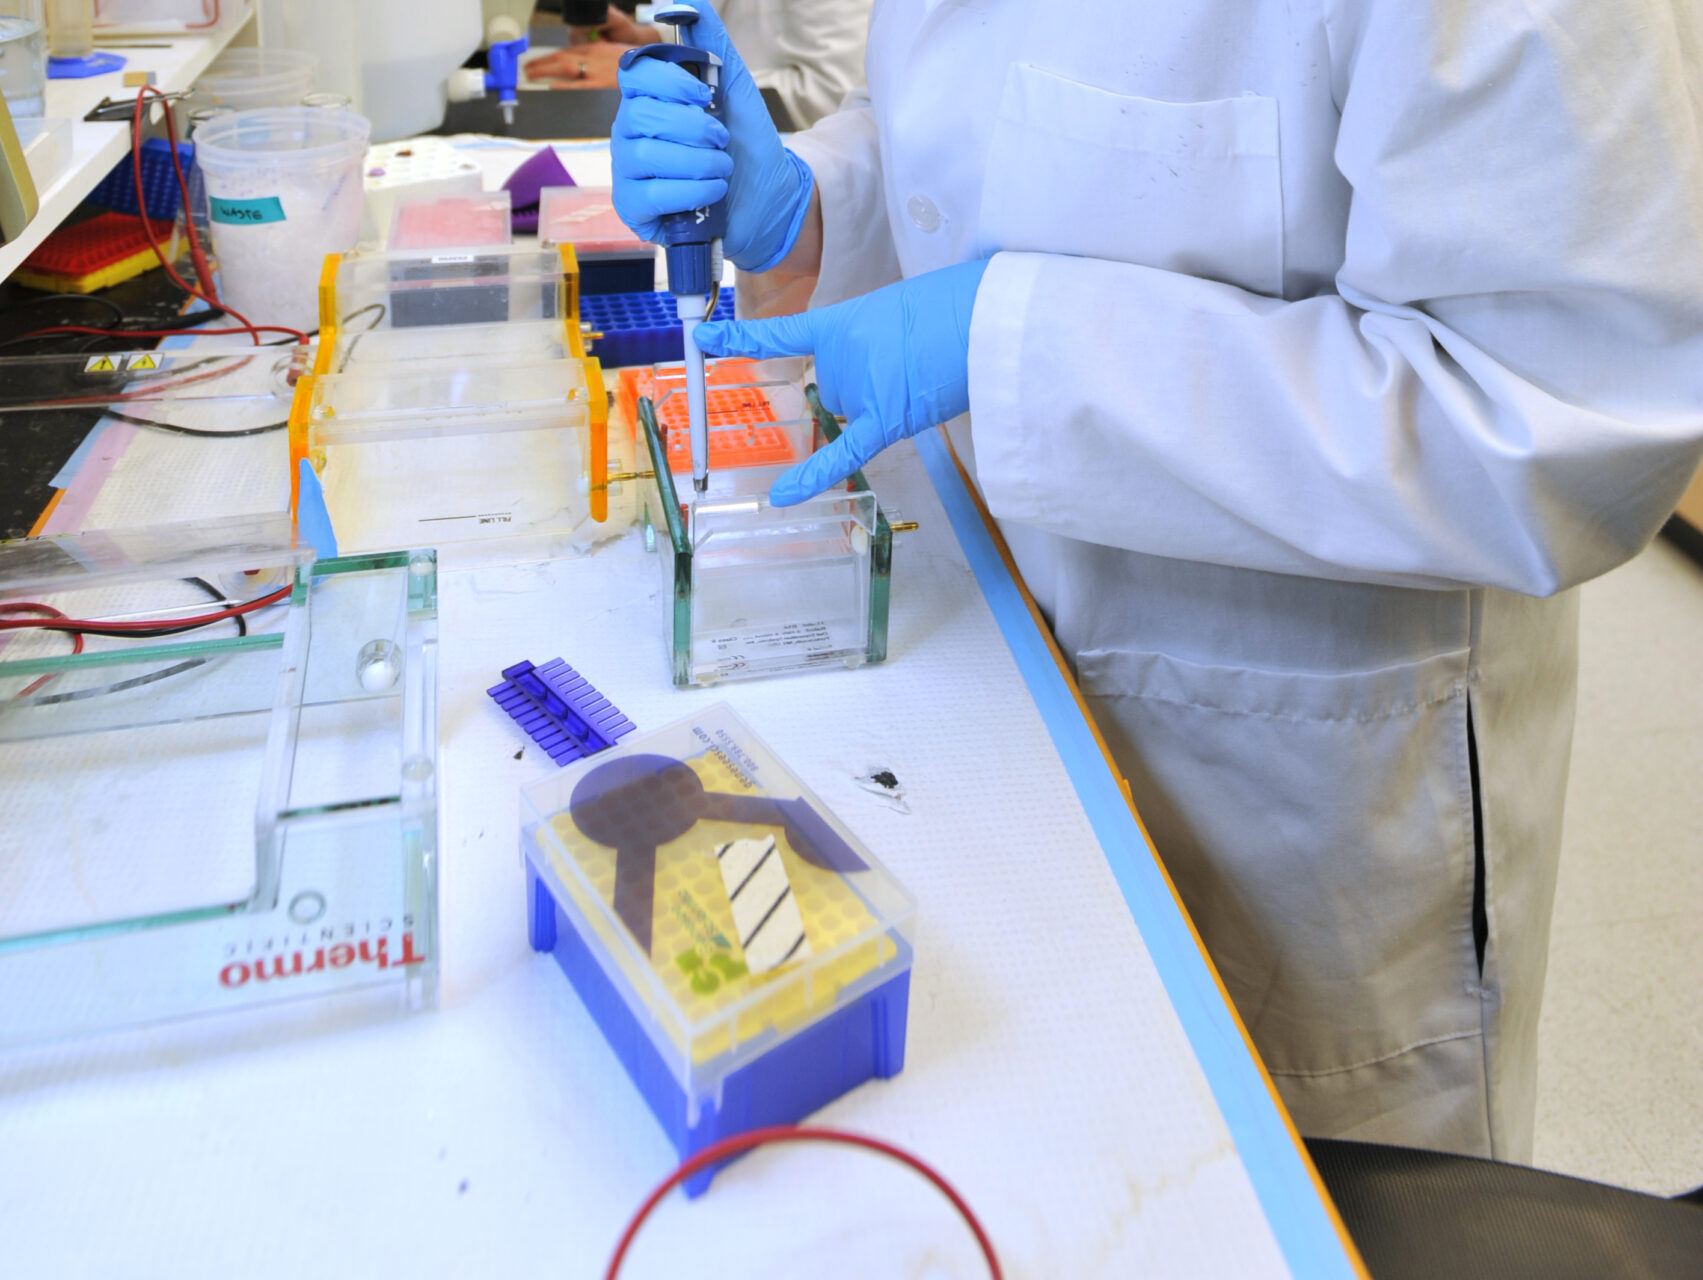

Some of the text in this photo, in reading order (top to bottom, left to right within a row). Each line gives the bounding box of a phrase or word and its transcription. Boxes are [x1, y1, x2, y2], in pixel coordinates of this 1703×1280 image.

[220, 206, 263, 220] WASTE
[224, 913, 414, 956] SCIENTIFIC
[218, 931, 426, 988] Thermo
